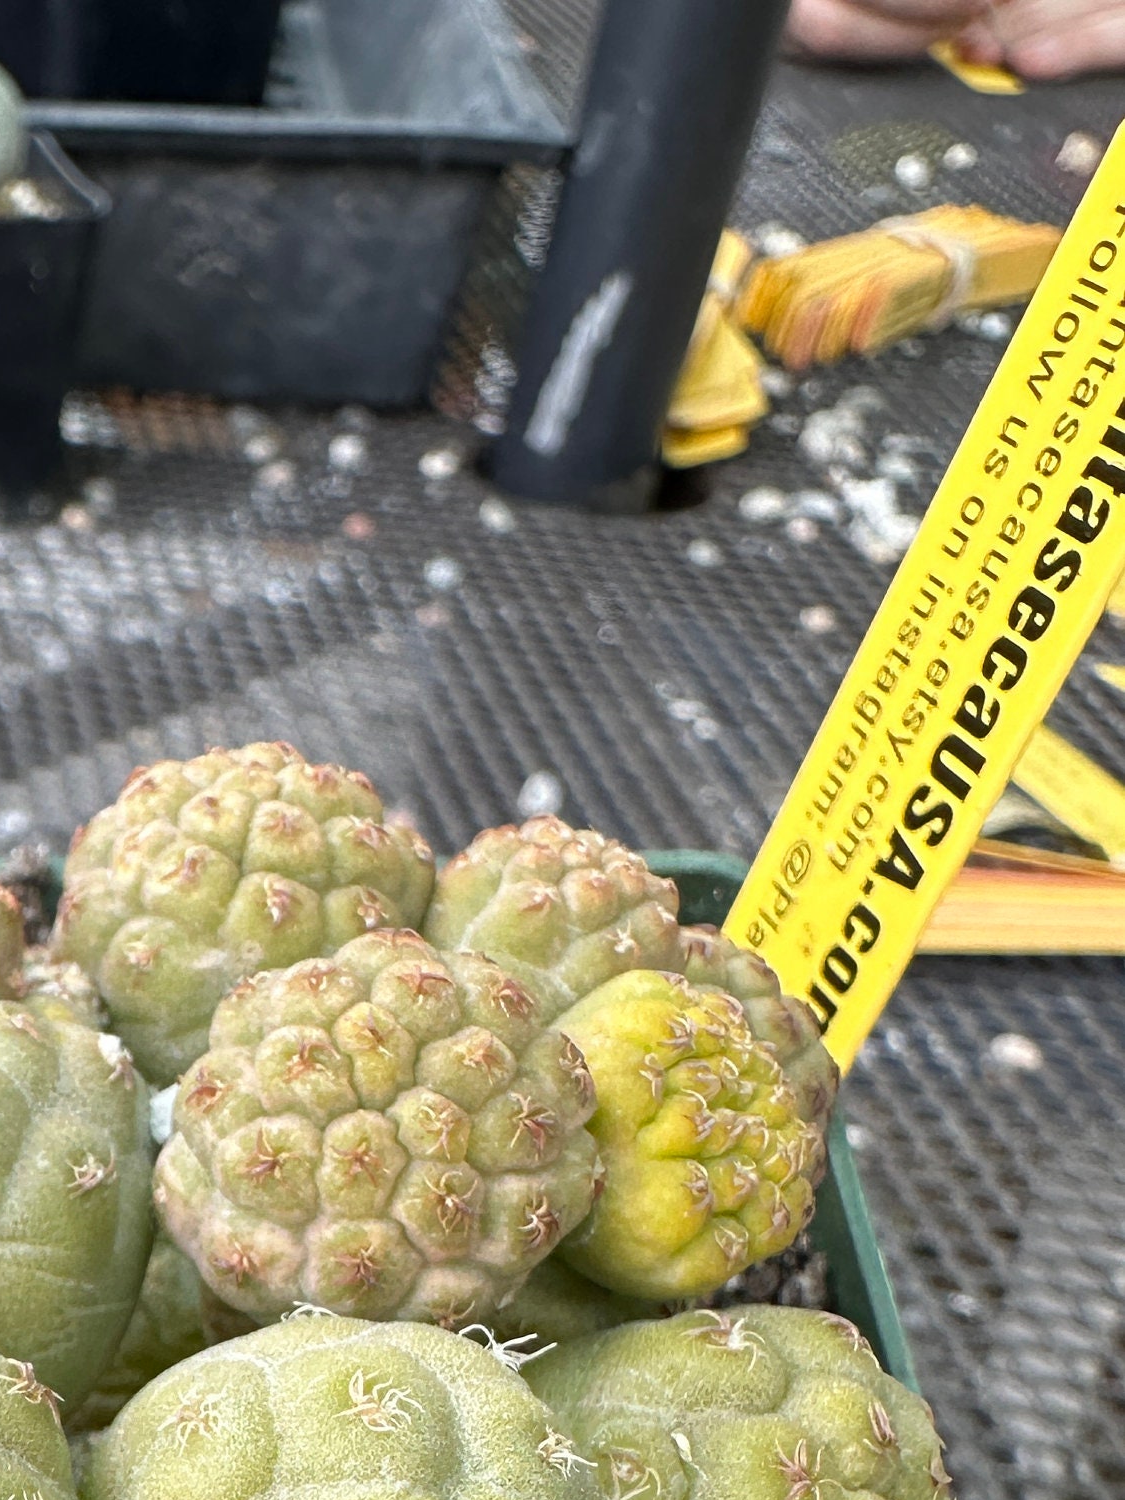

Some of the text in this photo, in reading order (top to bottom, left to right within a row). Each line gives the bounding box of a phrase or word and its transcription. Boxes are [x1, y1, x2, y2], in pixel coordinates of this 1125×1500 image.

[941, 494, 985, 561] on
[984, 415, 1028, 480] us
[828, 291, 1125, 873] ntasecausa.etsy.com
[806, 573, 954, 831] instagram:
